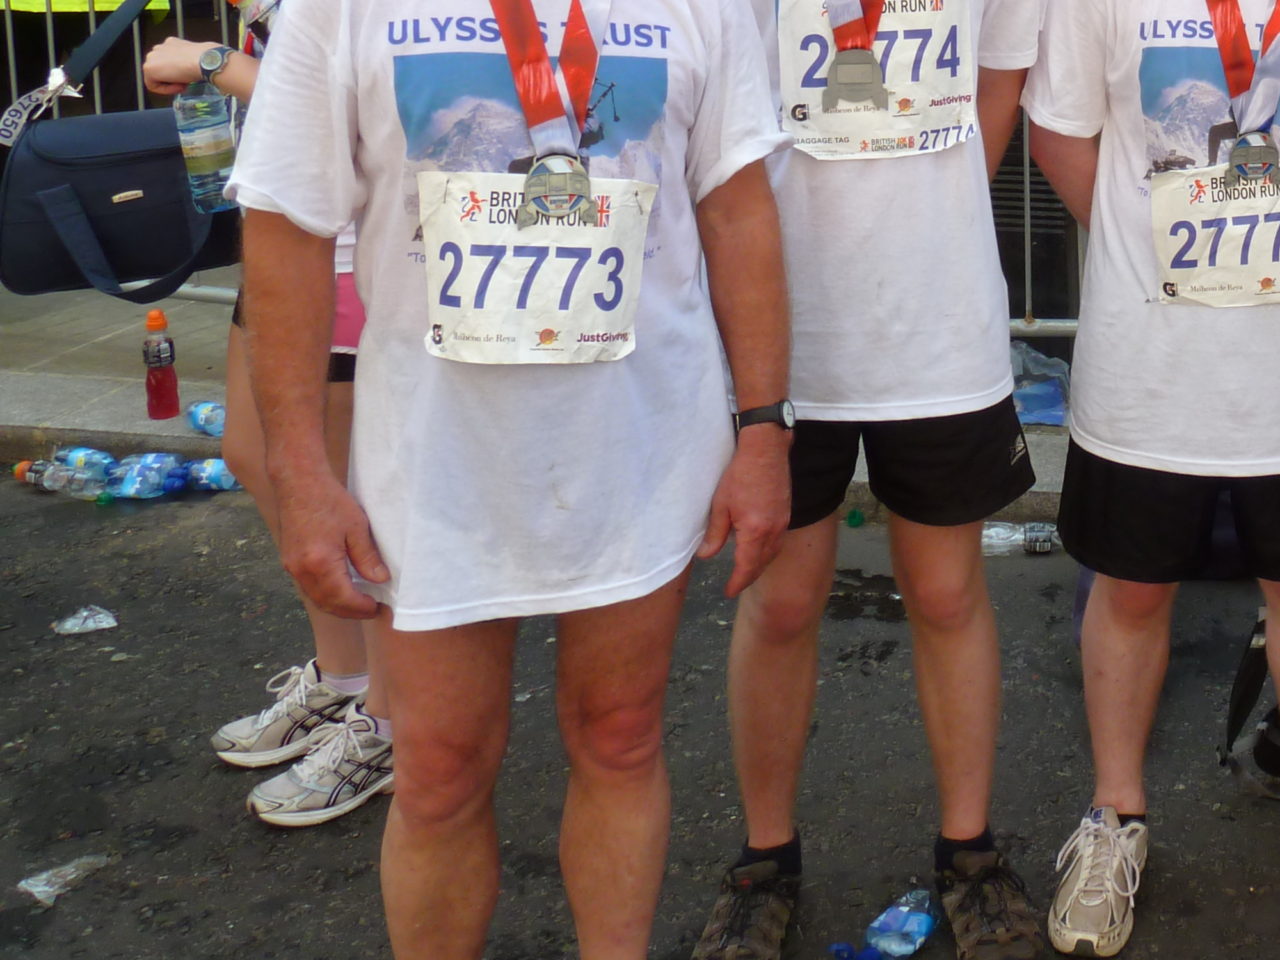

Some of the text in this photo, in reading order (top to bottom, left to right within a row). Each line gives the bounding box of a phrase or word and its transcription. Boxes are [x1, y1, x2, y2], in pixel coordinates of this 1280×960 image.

[901, 0, 926, 13] RUN
[388, 16, 549, 45] ULYSSS
[1139, 19, 1246, 40] ULYSS
[800, 25, 960, 88] 2774
[929, 94, 973, 107] JustGiving
[835, 136, 850, 144] TAG
[1211, 186, 1257, 203] LONDON
[439, 241, 625, 312] 27773
[577, 332, 631, 344] JustGiving
